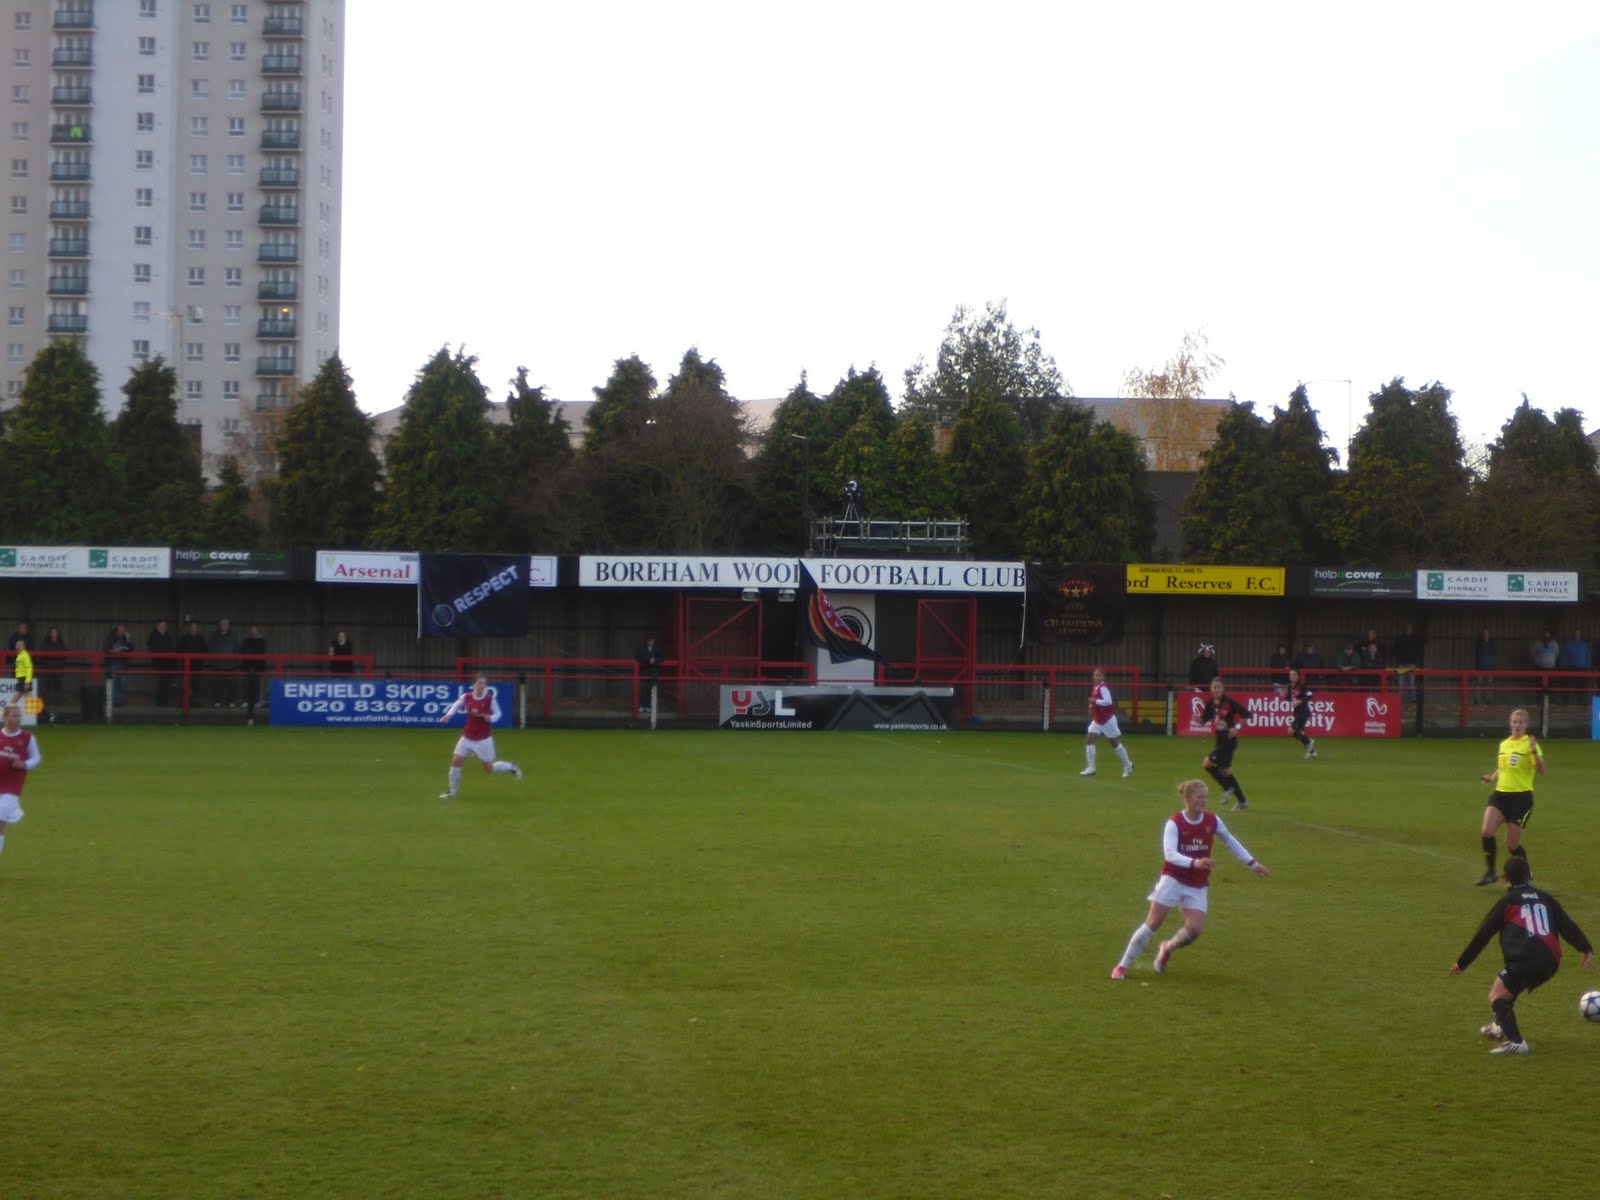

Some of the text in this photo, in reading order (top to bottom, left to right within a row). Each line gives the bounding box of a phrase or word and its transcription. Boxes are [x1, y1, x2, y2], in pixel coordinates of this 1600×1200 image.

[334, 564, 410, 579] Arsenal
[596, 562, 719, 582] BOREHAM
[821, 564, 952, 586] FOOTBALL
[963, 567, 1025, 587] CLUB
[453, 565, 520, 613] RESPECT
[1166, 576, 1233, 589] Reserves
[1246, 577, 1276, 590] F.C.
[284, 684, 376, 698] ENFIELD
[386, 685, 449, 700] SKIPS
[297, 701, 345, 713] 020
[353, 701, 414, 713] 8367
[874, 723, 948, 731] www.yaskinsports.co.uk
[1193, 838, 1203, 846] Fly
[1520, 903, 1550, 936] 10
